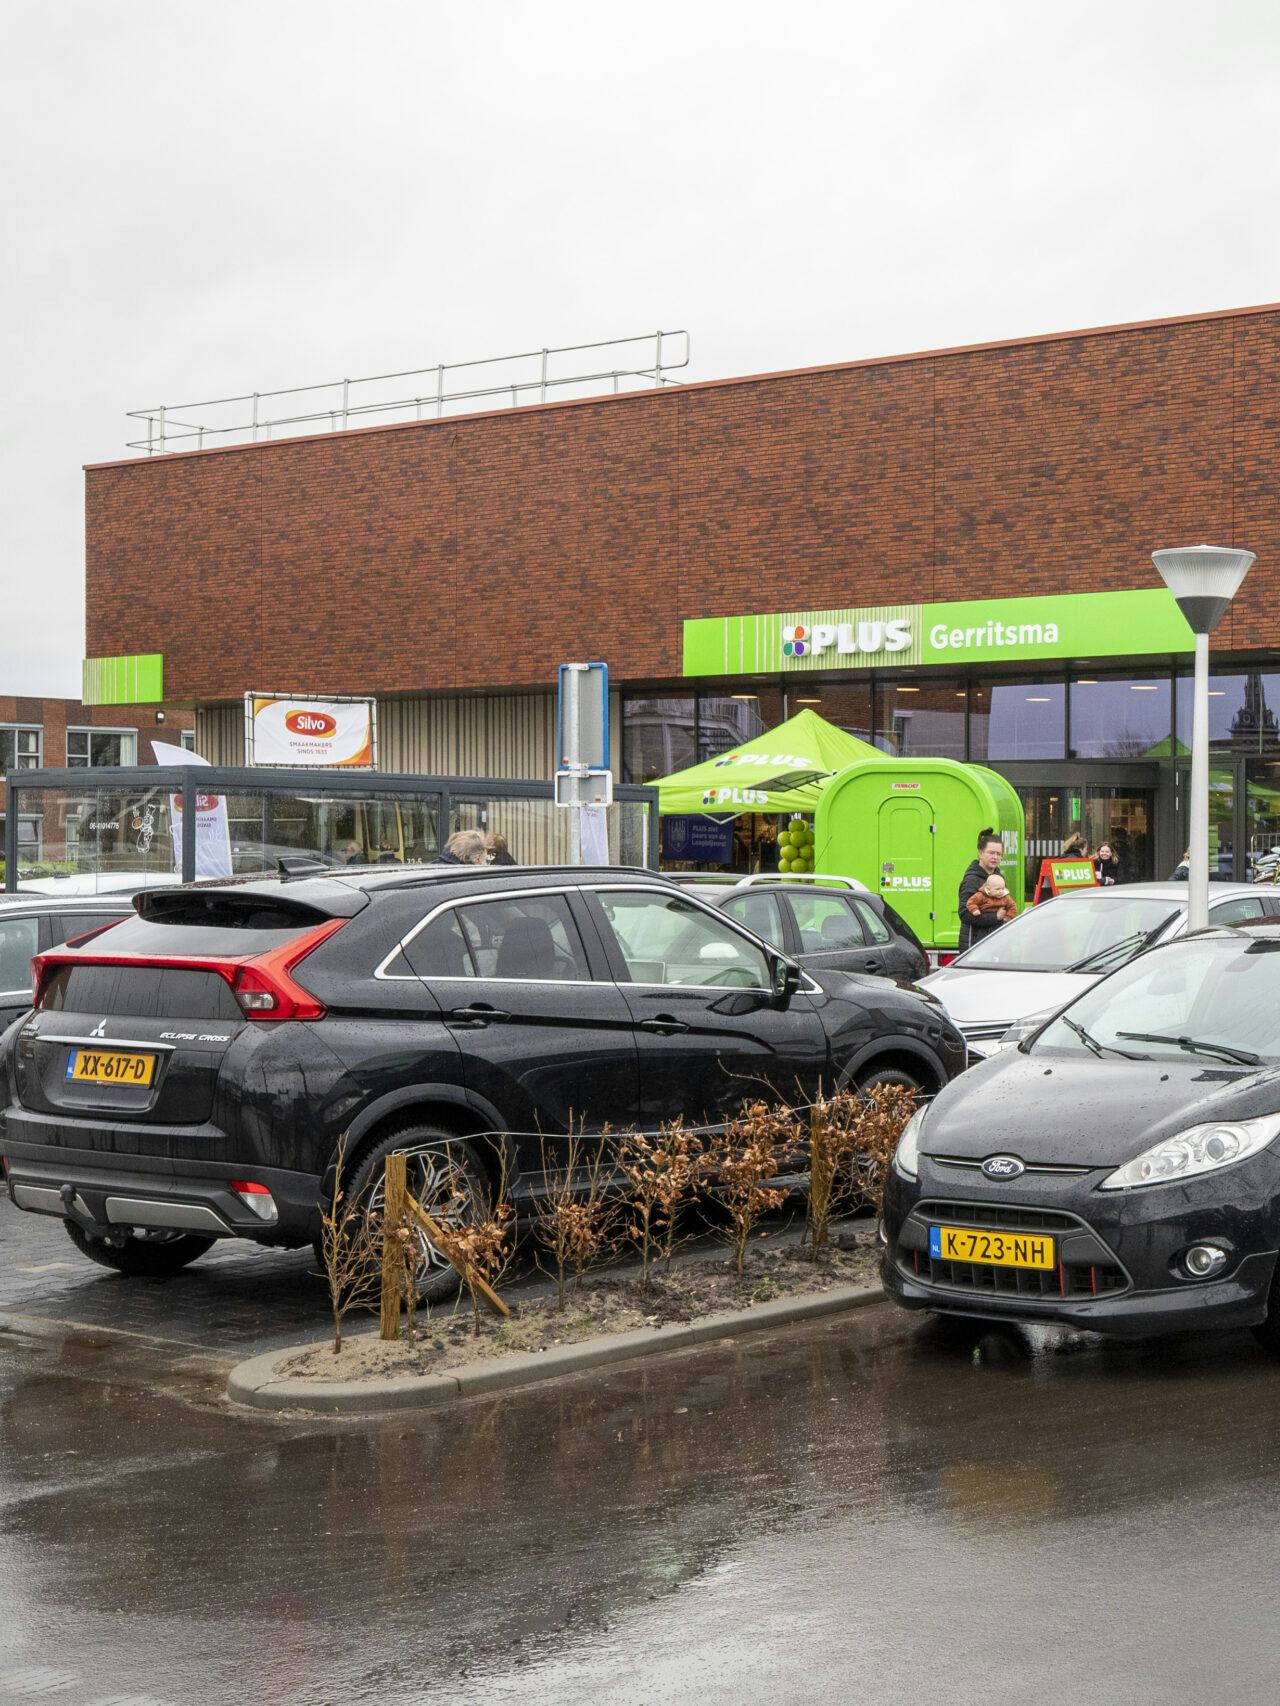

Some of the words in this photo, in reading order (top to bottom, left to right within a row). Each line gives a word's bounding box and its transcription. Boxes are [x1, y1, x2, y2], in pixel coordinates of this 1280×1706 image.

[811, 619, 913, 656] PLUS
[929, 620, 1059, 650] Gerritsma
[296, 715, 326, 731] Silvo
[735, 753, 813, 768] PLUS
[717, 787, 769, 805] PLUS
[892, 876, 932, 888] PLUS
[1063, 868, 1091, 881] PLUS
[159, 1031, 198, 1041] ECLIPSE
[198, 1034, 231, 1042] CROSS
[79, 1054, 146, 1080] XX-617-D
[988, 1159, 1013, 1174] Ford
[932, 1244, 941, 1253] NL
[946, 1232, 1046, 1264] K-723-NH
